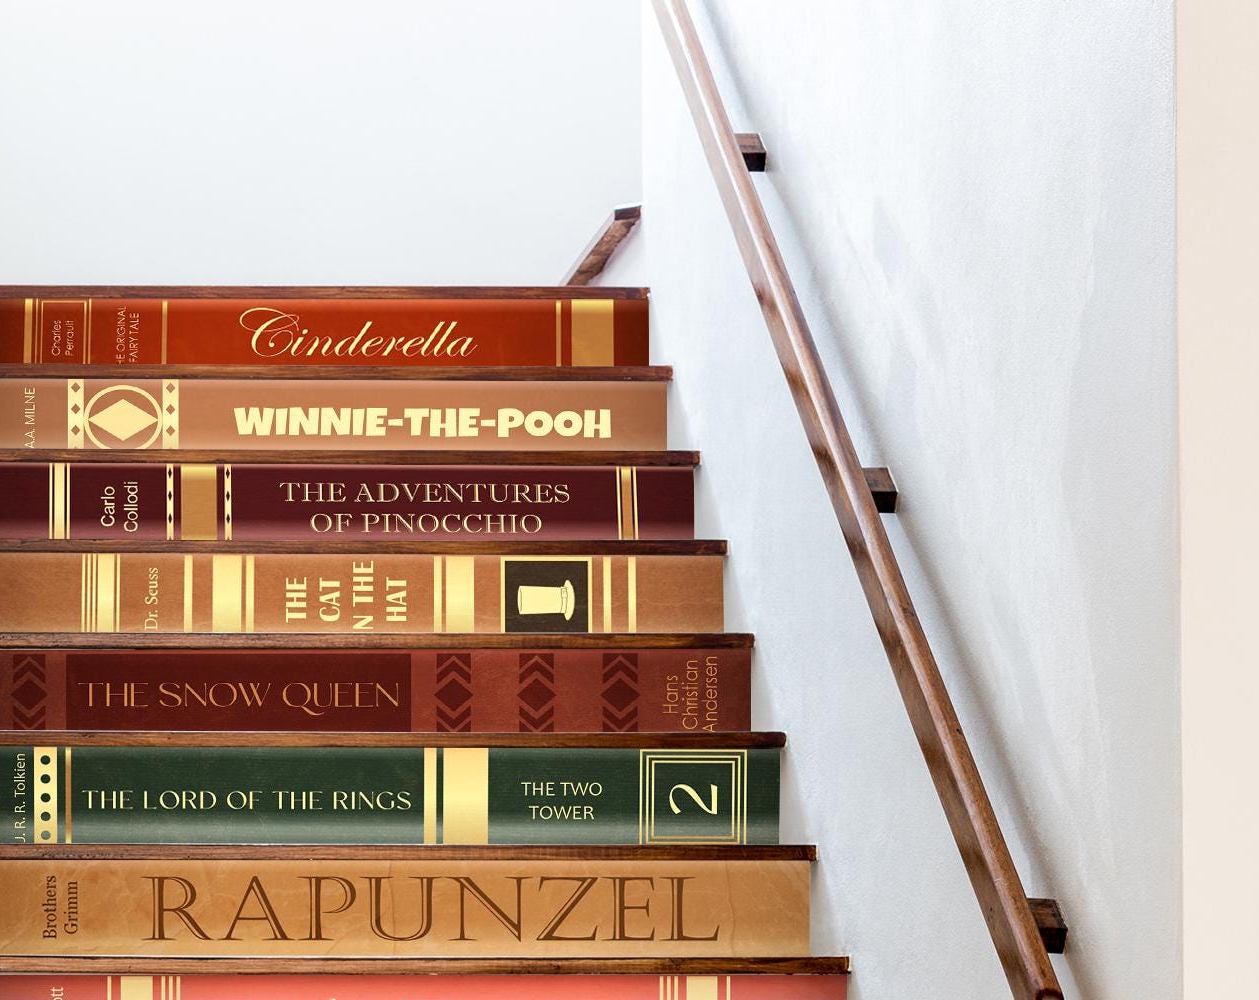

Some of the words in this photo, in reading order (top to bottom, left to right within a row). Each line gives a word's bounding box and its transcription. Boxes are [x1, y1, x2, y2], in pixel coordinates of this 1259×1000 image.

[51, 319, 62, 357] Charles
[64, 319, 75, 357] Perrault
[115, 305, 127, 353] ORIGINAL
[128, 312, 140, 335] TALE
[239, 307, 478, 357] Cinderella
[115, 353, 127, 365] HE
[128, 336, 140, 363] FAIRY
[23, 386, 36, 425] MILNE
[234, 407, 611, 438] WINNIE-THE-POOH
[100, 485, 116, 527] Carlo
[123, 481, 139, 533] Collodi
[280, 483, 346, 502] THE
[354, 483, 570, 503] ADVENTURES
[310, 513, 352, 532] OF
[361, 513, 542, 533] PINOCCHIO
[144, 567, 159, 606] Seuss
[286, 577, 306, 622] THE
[319, 578, 340, 621] CAT
[353, 560, 374, 606] THE
[386, 577, 407, 621] HAT
[144, 609, 159, 631] Dr.
[352, 615, 374, 630] N
[77, 682, 149, 707] THE
[159, 682, 271, 708] SNOW
[282, 682, 399, 716] QUEEN
[662, 674, 679, 715] Hans
[681, 659, 699, 731] Christian
[702, 655, 718, 733] Andersen
[13, 752, 27, 799] Tolkien
[520, 781, 556, 797] THE
[559, 781, 604, 798] TWO
[13, 799, 27, 814] R.
[82, 790, 133, 810] THE
[143, 790, 216, 810] LORD
[226, 790, 263, 810] OF
[273, 790, 323, 810] THE
[332, 790, 412, 811] RINGS
[528, 804, 596, 821] TOWER
[669, 783, 718, 815] 2
[13, 814, 27, 830] R.
[13, 829, 27, 843] J.
[42, 874, 58, 941] Brothers
[63, 879, 79, 936] Grimm
[141, 876, 720, 942] RAPUNZEL
